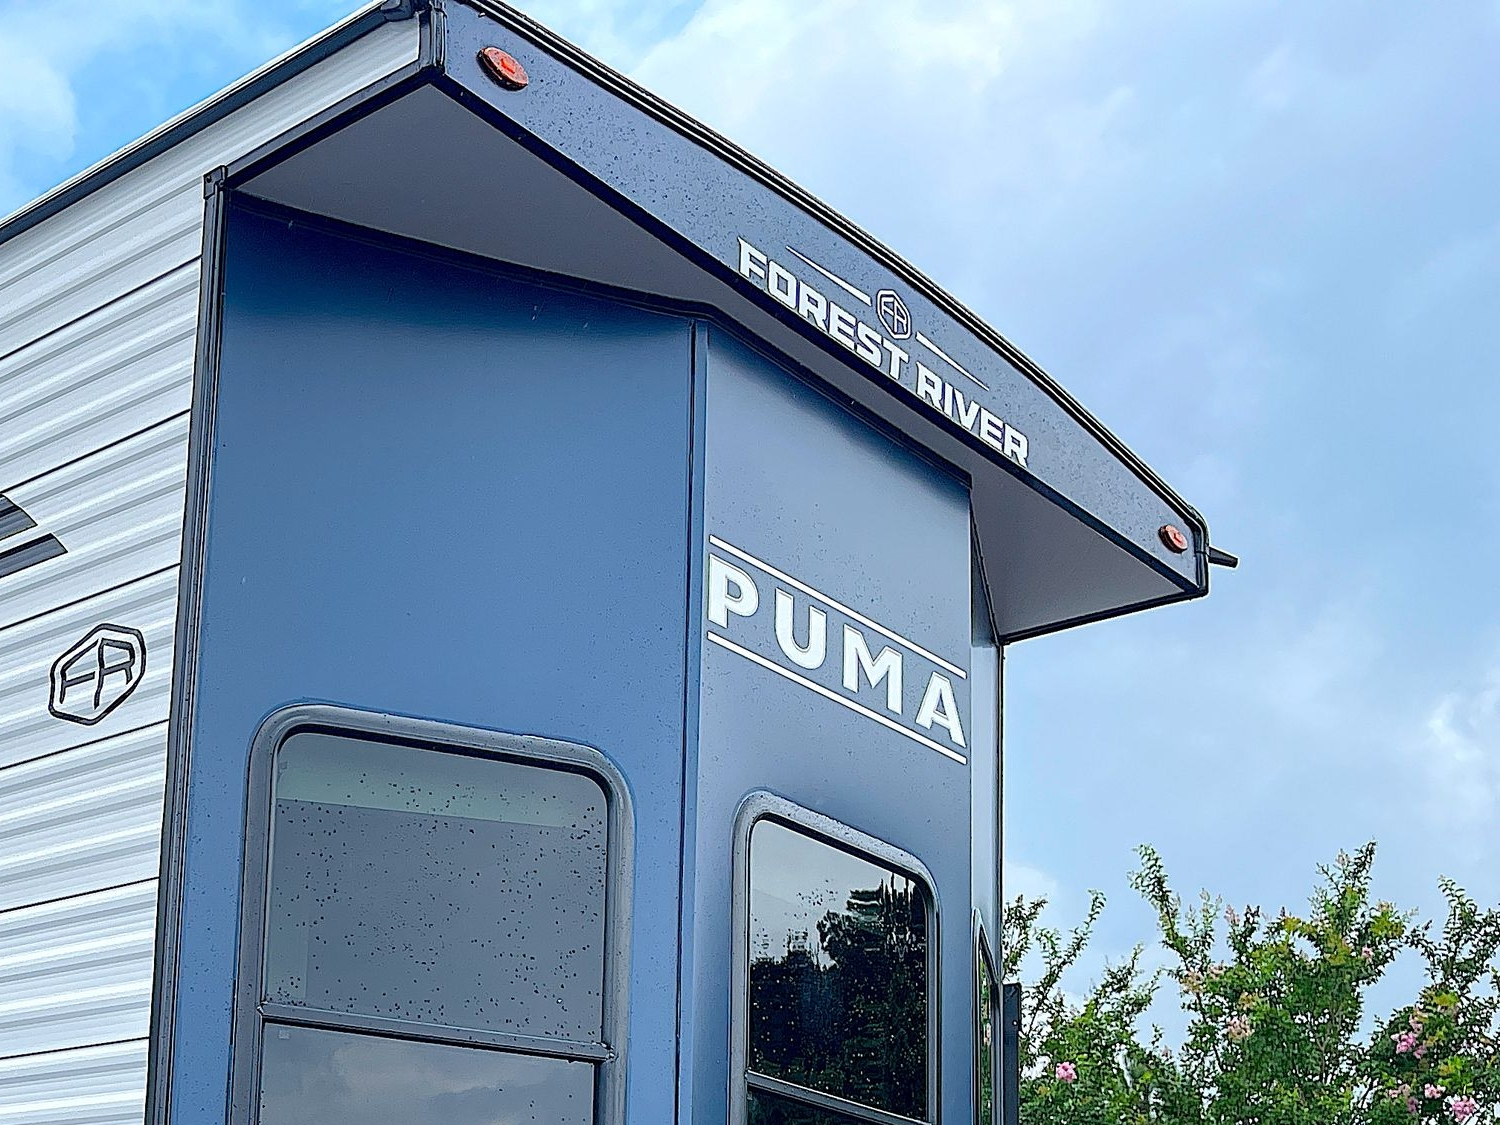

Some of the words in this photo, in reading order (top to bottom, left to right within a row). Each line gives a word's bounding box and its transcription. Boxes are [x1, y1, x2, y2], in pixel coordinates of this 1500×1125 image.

[737, 236, 909, 382] FOREST
[915, 361, 1030, 468] RIVER
[707, 552, 968, 749] PUMA
